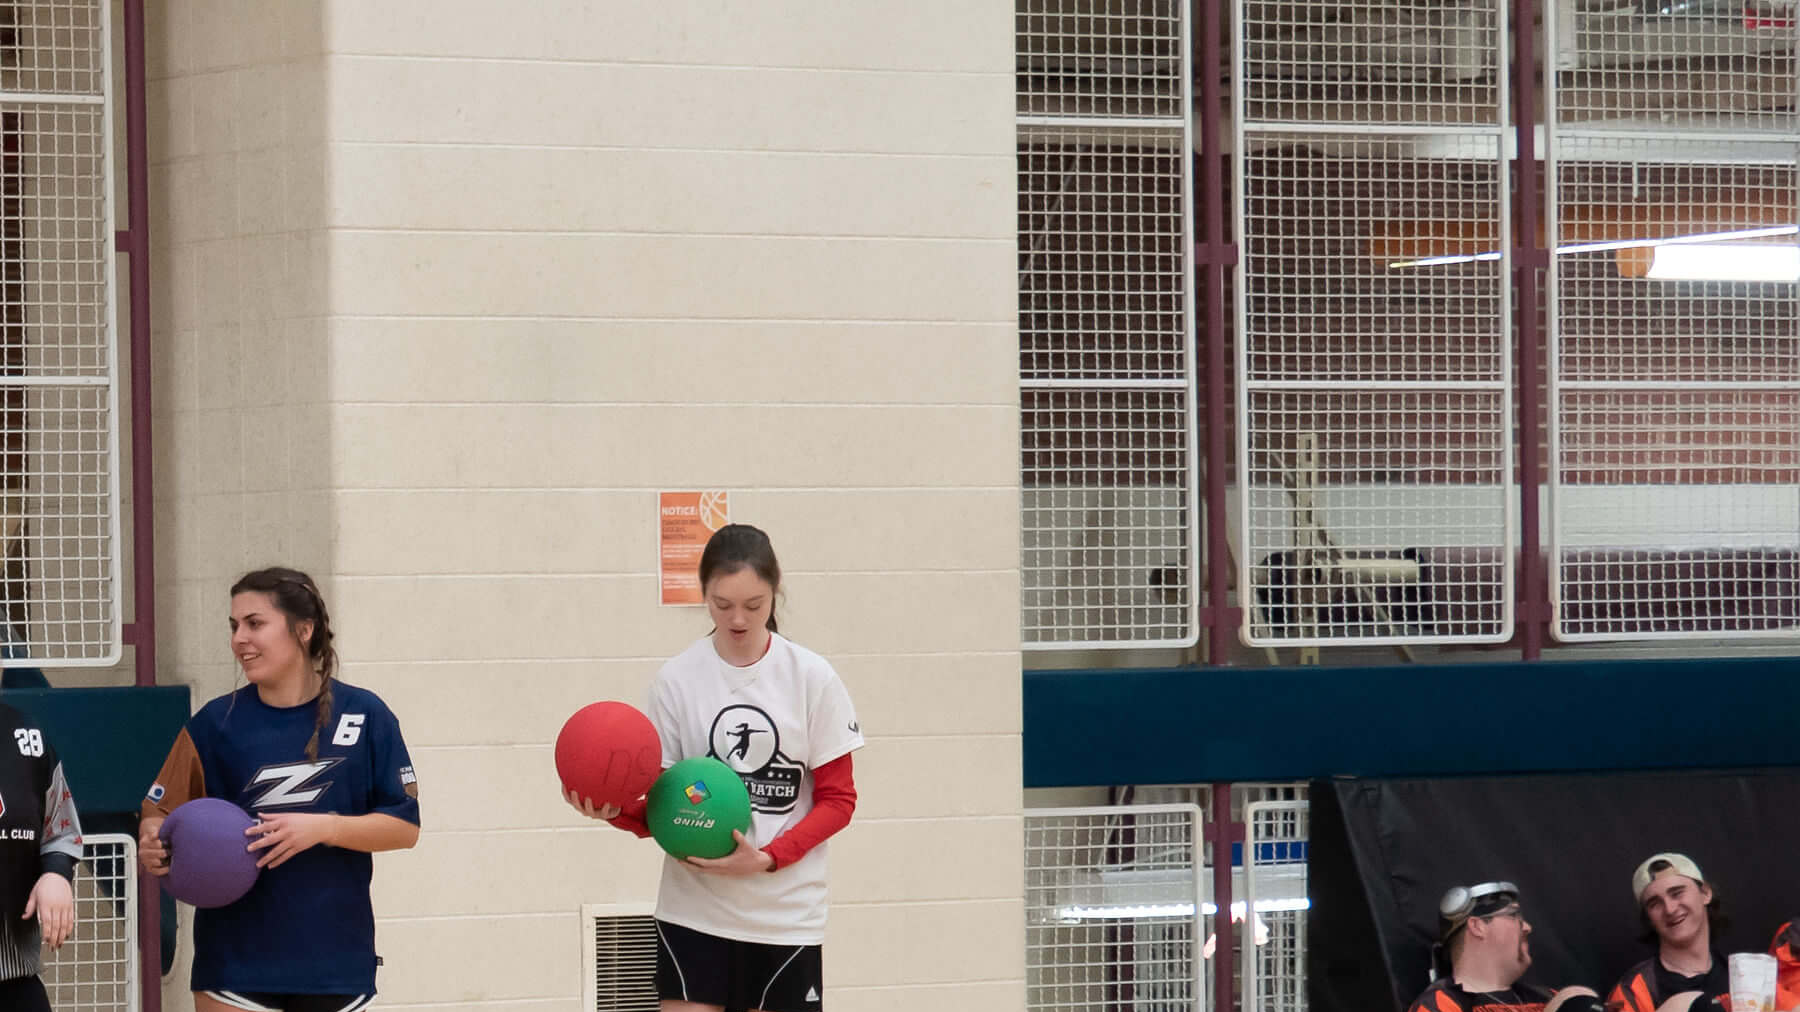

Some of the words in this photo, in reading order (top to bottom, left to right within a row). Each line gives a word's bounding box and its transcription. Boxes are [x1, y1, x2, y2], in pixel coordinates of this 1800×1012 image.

[14, 728, 44, 757] 28
[331, 713, 366, 746] 6
[242, 756, 348, 810] Z
[11, 829, 35, 840] CLUB
